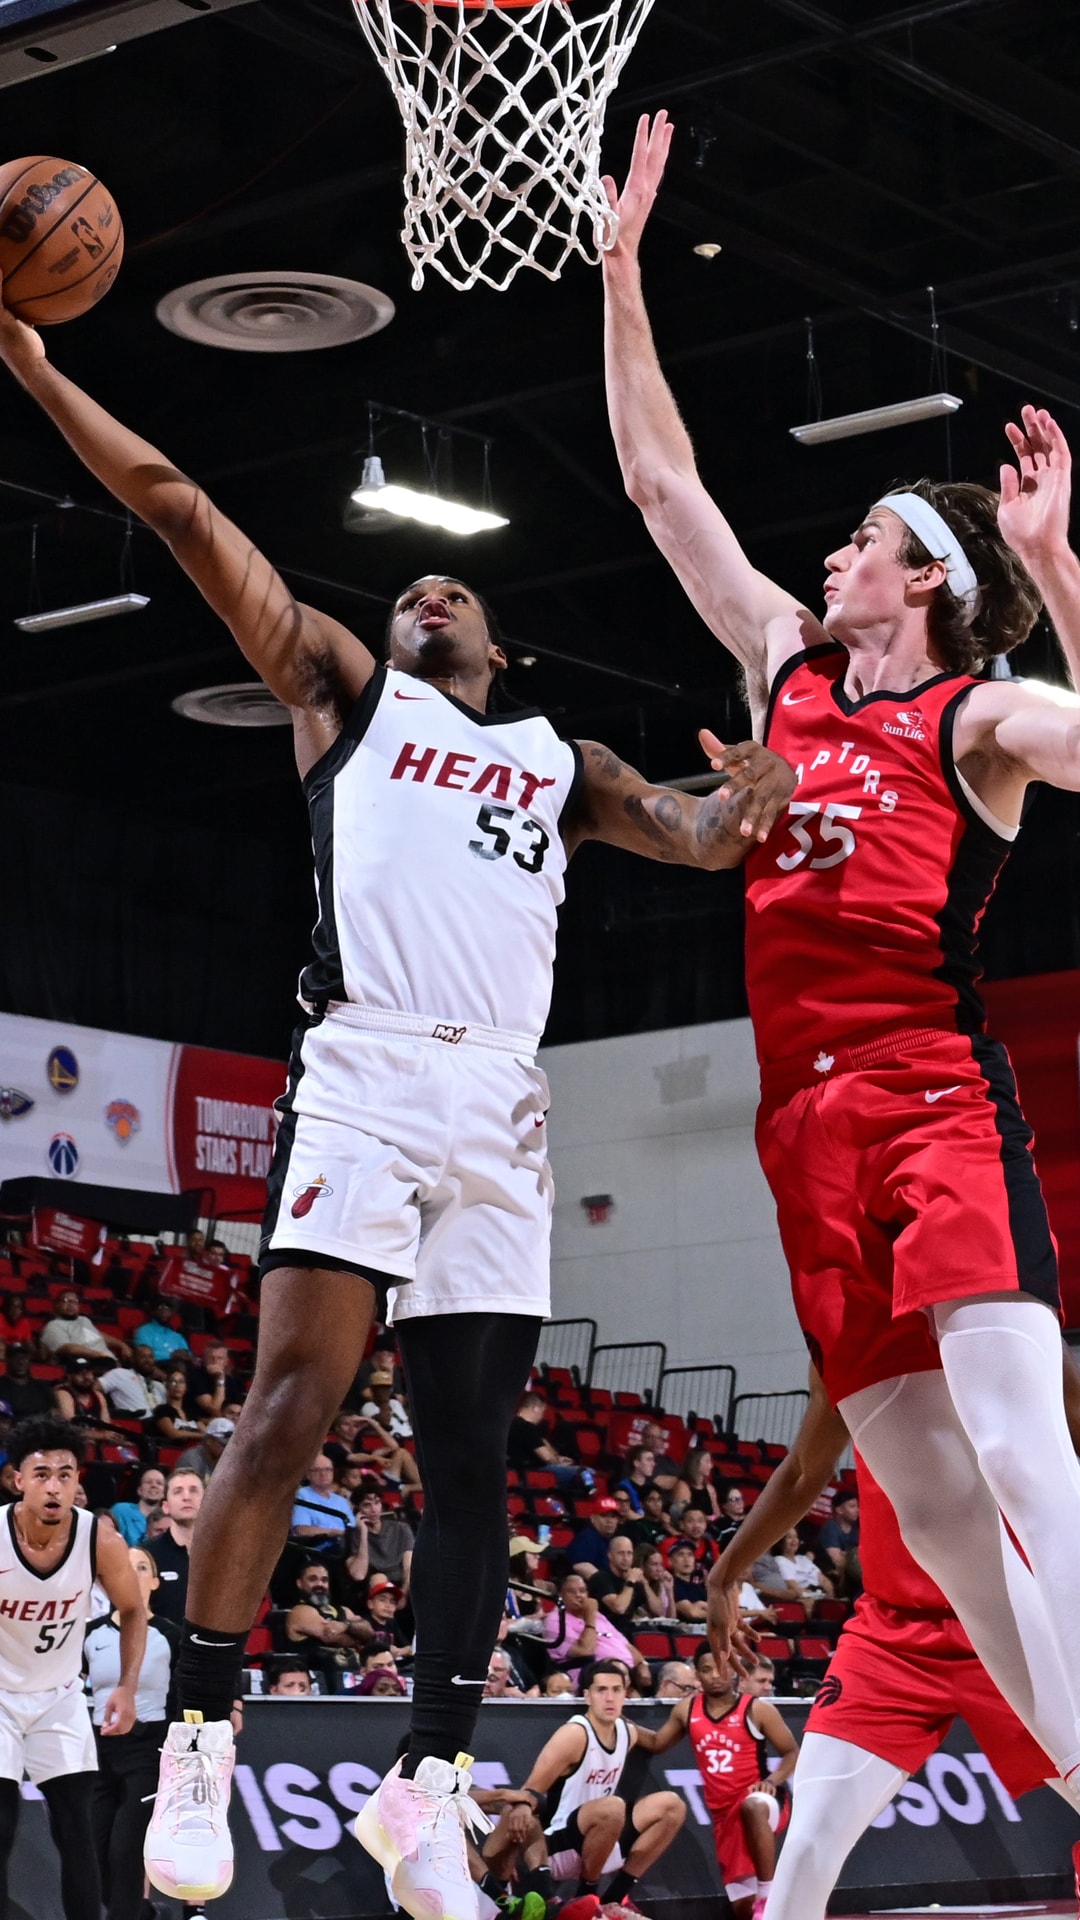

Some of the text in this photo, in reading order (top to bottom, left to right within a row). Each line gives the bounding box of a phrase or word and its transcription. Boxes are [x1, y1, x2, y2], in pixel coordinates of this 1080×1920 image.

[1, 166, 86, 243] Wilson
[882, 722, 926, 741] Sun Life
[390, 742, 556, 810] HEAT
[467, 802, 550, 875] 53
[775, 801, 863, 871] 35
[195, 1133, 272, 1179] STARS PLAY
[0, 1589, 83, 1622] HEAT
[34, 1619, 77, 1654] 57
[585, 1767, 620, 1785] HEAT
[704, 1748, 734, 1774] 32
